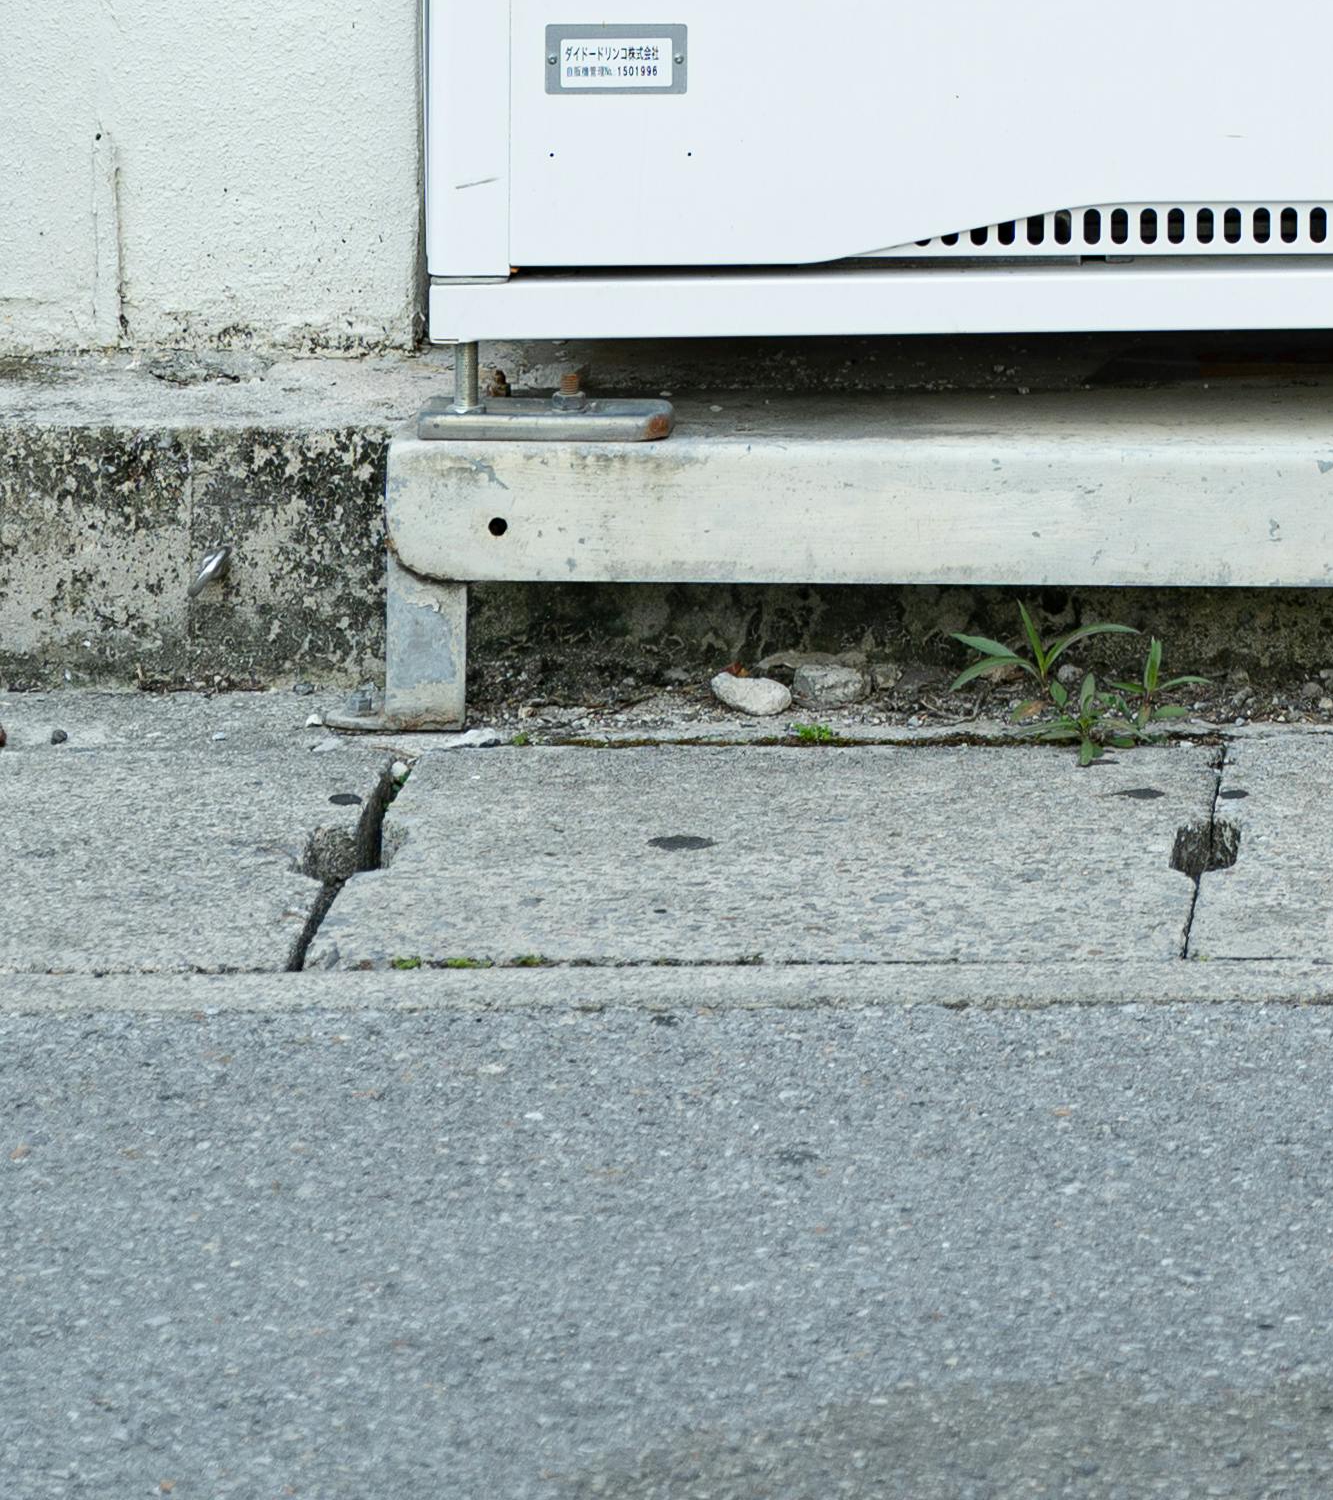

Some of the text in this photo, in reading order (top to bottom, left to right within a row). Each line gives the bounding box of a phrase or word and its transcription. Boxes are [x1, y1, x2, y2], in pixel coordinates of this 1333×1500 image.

[564, 46, 660, 60] ダイドードリンコ株式会社
[617, 66, 658, 77] 1501996
